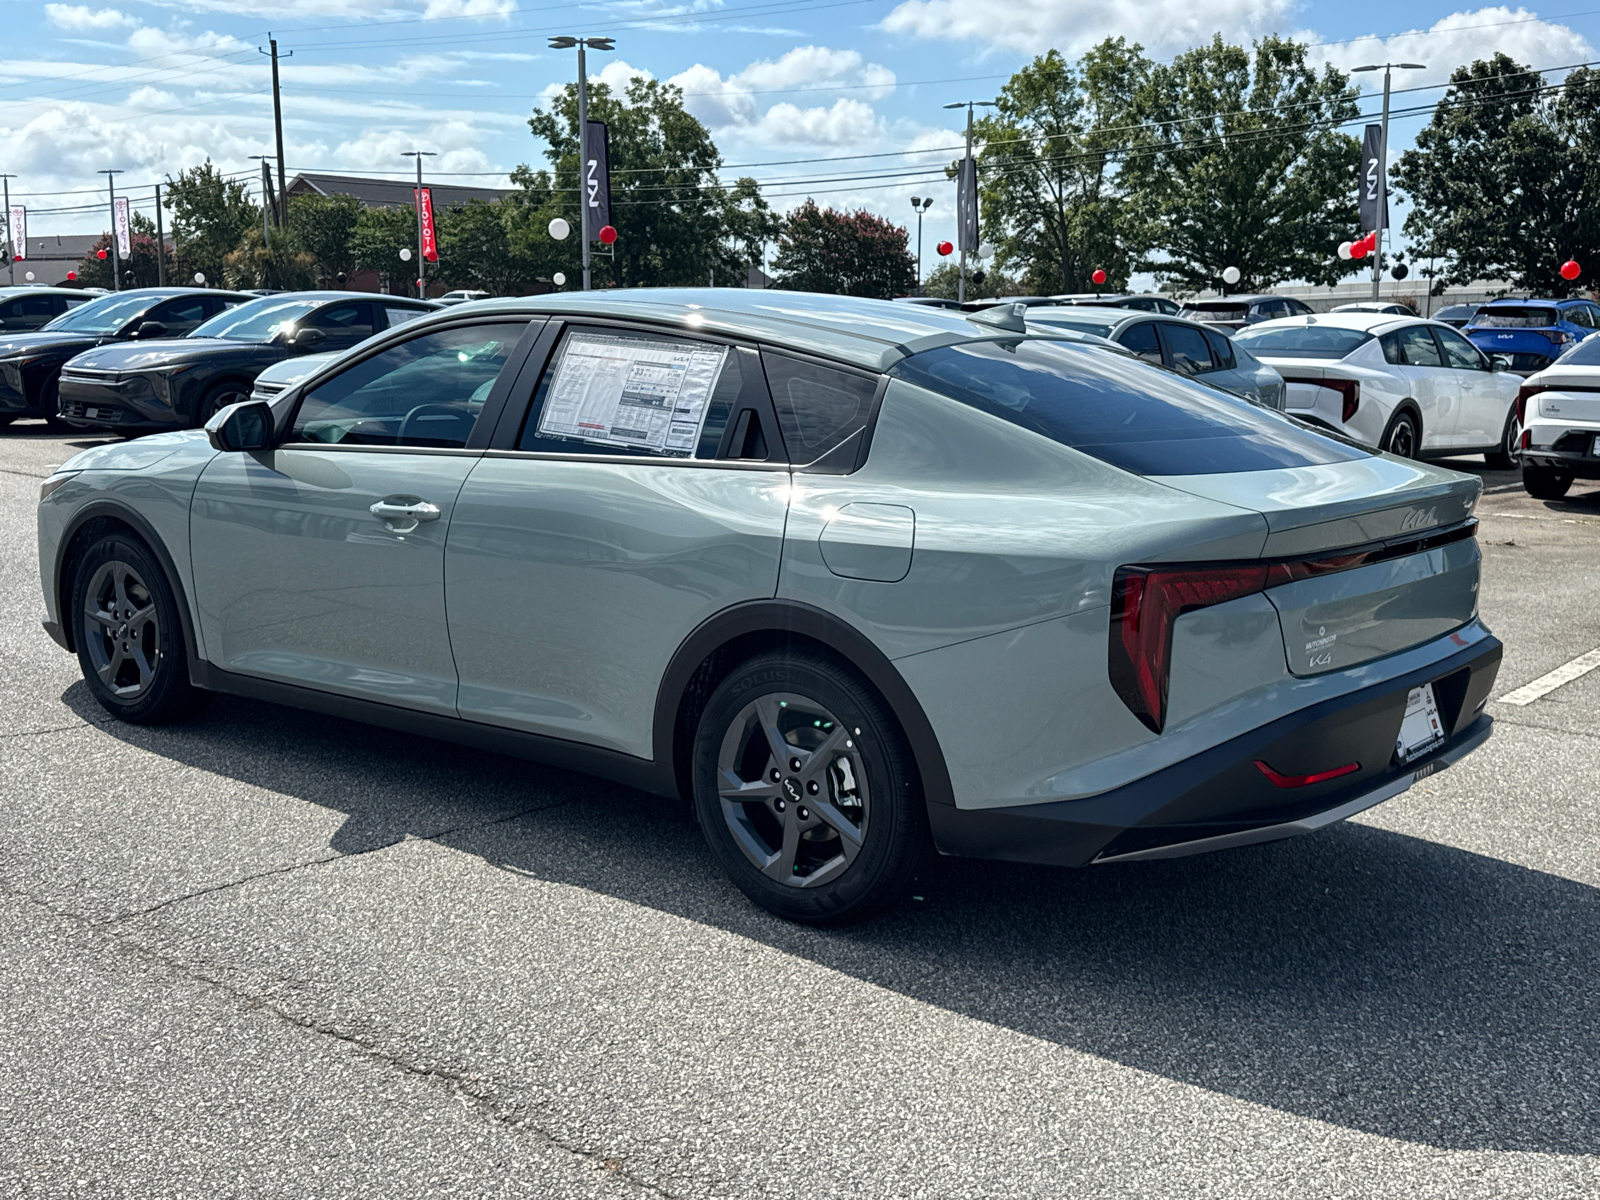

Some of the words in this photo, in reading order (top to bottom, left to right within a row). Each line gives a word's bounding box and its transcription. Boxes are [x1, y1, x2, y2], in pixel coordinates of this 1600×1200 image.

[118, 209, 127, 251] TOYOTA
[421, 202, 432, 254] TOYOTA
[634, 367, 644, 376] 33
[1400, 506, 1438, 530] KIA
[1309, 652, 1332, 668] K4
[731, 670, 787, 697] SOLUS
